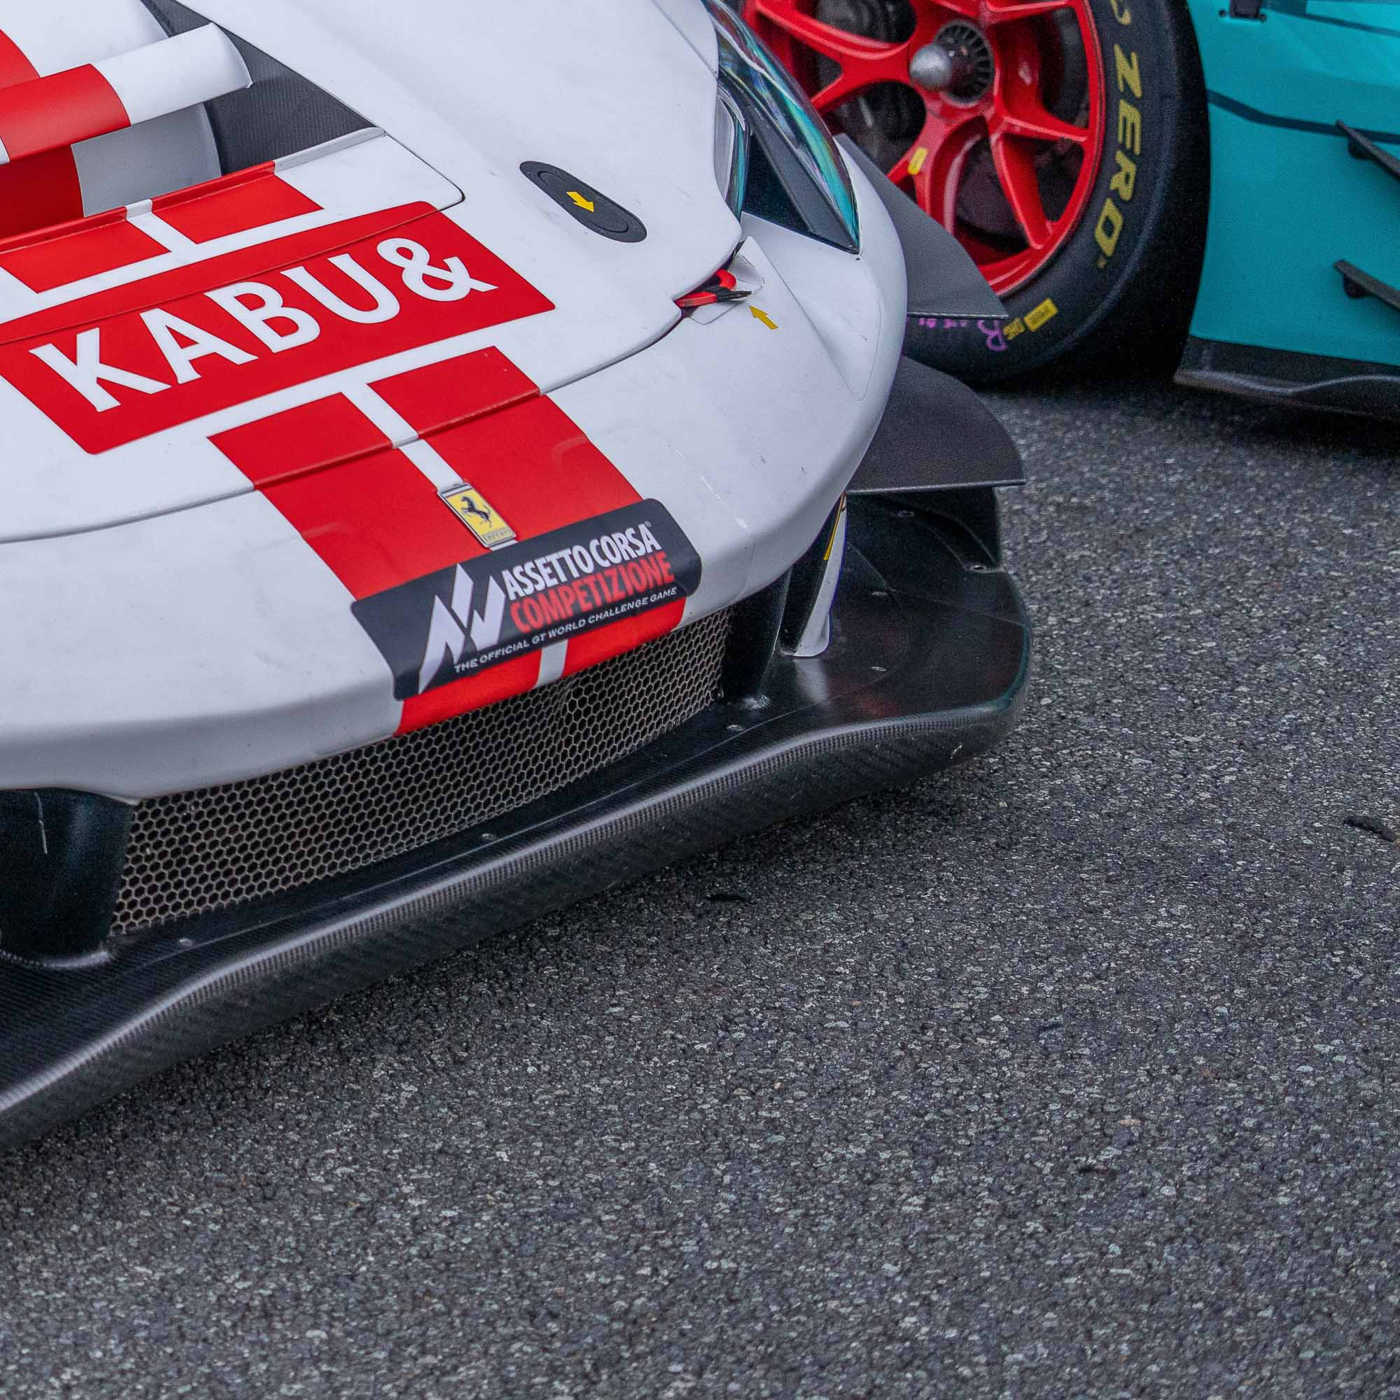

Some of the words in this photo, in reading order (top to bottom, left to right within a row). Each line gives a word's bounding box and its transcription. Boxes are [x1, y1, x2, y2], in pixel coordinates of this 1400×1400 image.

[1092, 49, 1144, 262] ZERO
[29, 236, 500, 413] KABU&
[499, 544, 595, 601] ASSETTO
[587, 525, 664, 568] CORSA
[510, 551, 675, 634] COMPETIZIONE
[453, 657, 478, 674] THE
[479, 639, 530, 665] OFFICIAL
[531, 633, 547, 646] GT
[547, 618, 588, 640] WORLD
[587, 596, 650, 626] CHALLENGE
[649, 585, 678, 603] GAME
